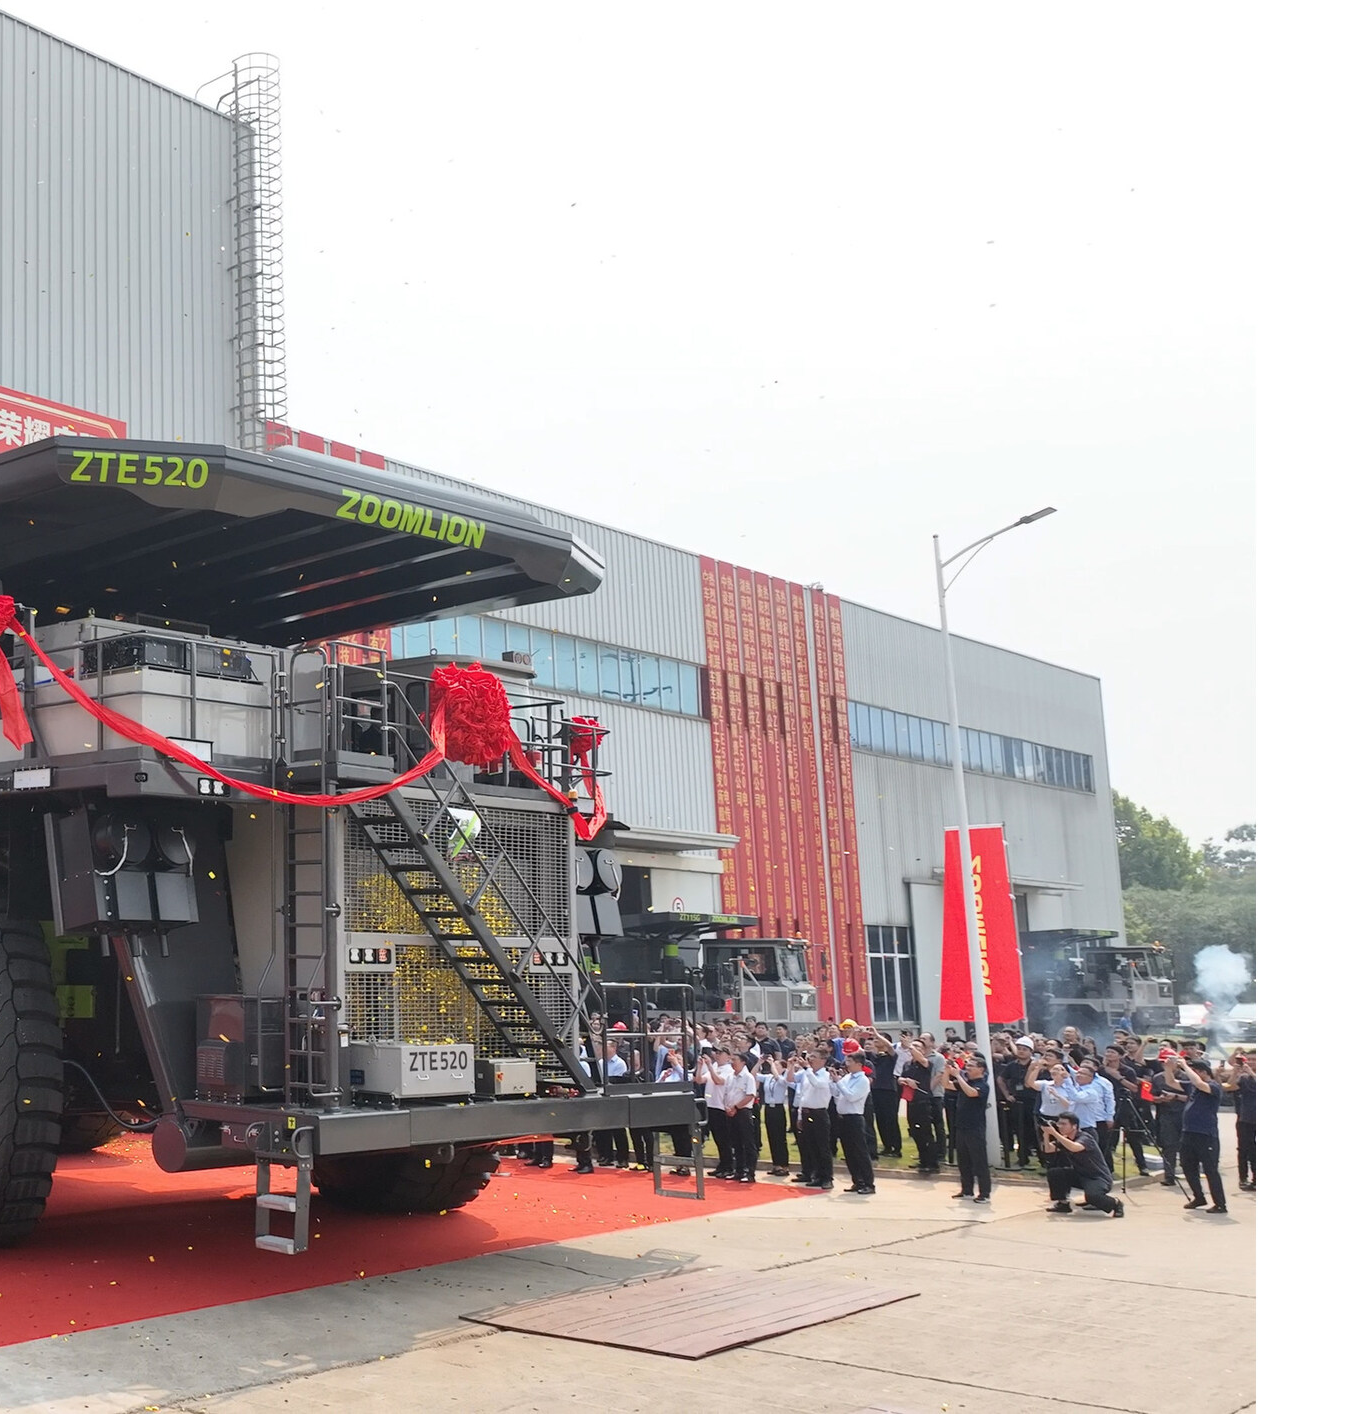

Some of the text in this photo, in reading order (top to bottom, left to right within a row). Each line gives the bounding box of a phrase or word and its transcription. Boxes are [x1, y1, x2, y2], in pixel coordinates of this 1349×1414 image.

[70, 450, 209, 489] ZTE520
[336, 489, 486, 550] ZOOMLION
[409, 1050, 468, 1072] ZTE520
